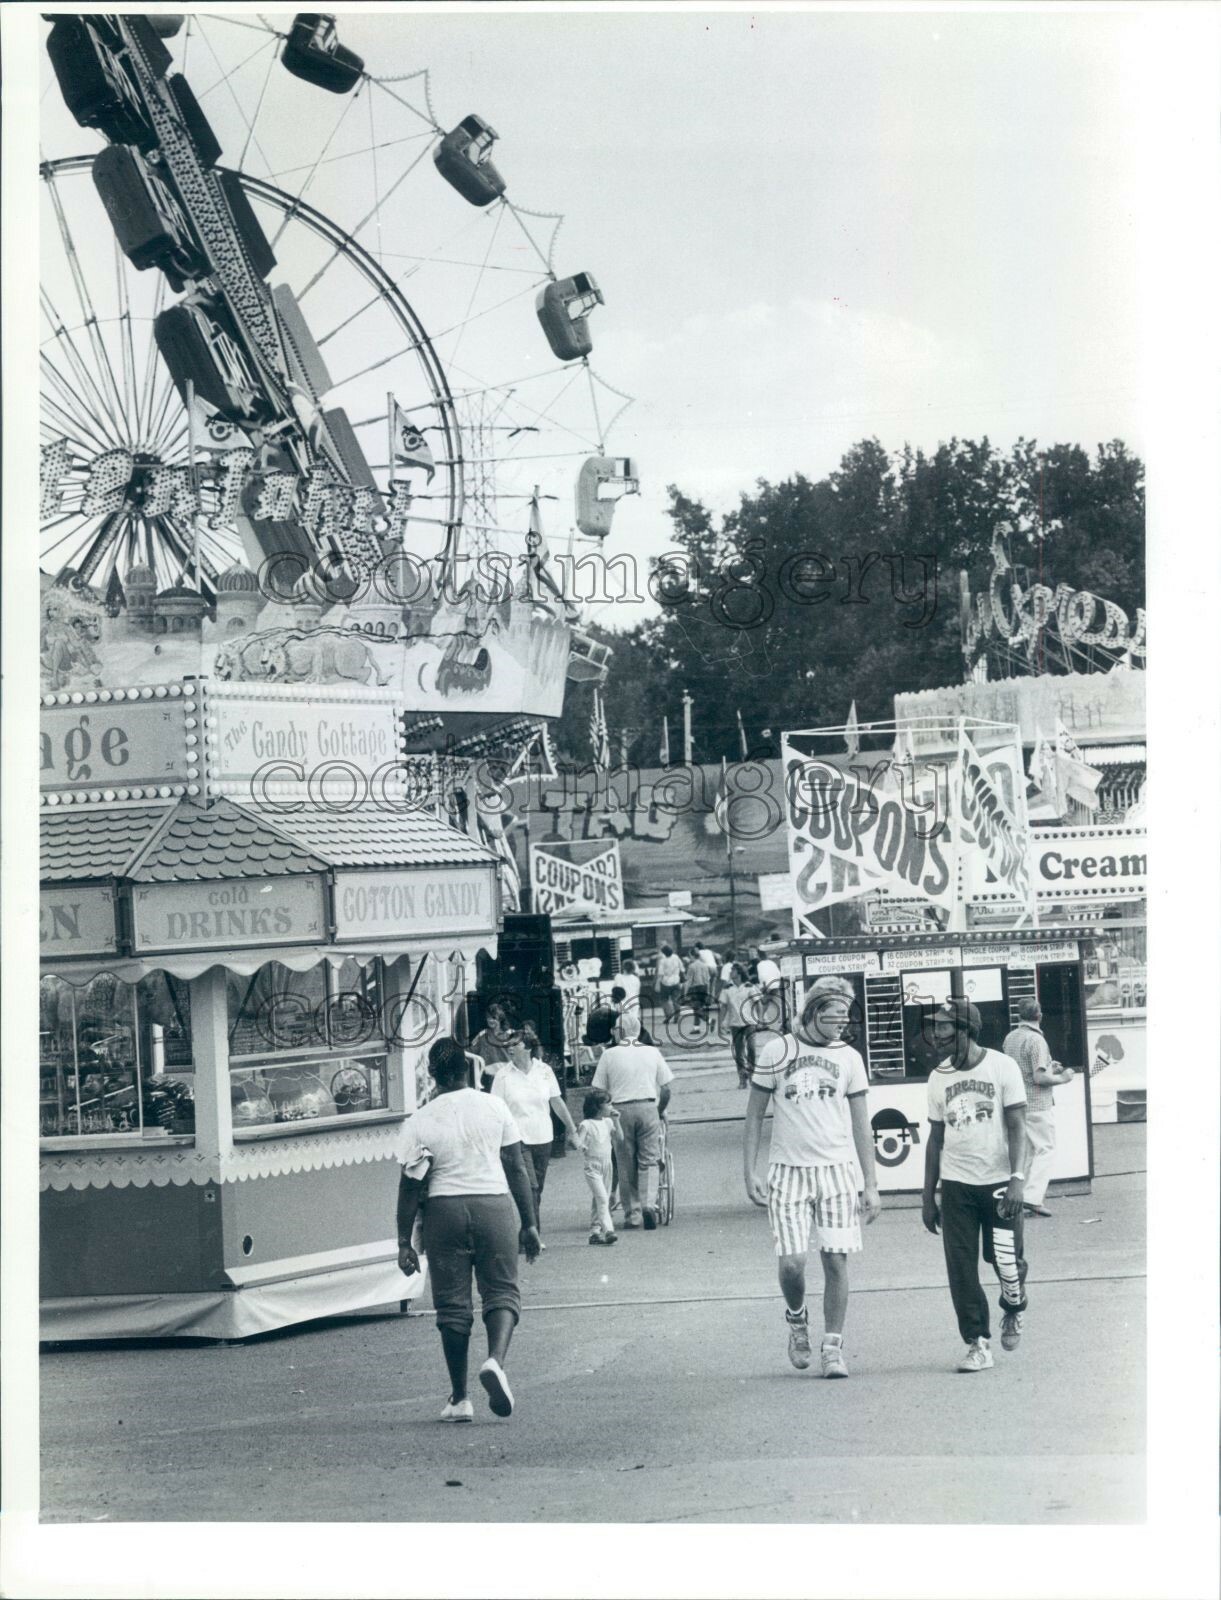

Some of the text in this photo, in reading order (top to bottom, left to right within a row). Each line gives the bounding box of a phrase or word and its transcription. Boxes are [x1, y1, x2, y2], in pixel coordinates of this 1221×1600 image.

[224, 720, 387, 765] The Candy Cottage
[788, 759, 949, 896] COUPONS
[1039, 851, 1146, 881] Cream
[535, 855, 620, 910] COUPONS
[344, 882, 481, 922] COTTON CANDY
[167, 907, 292, 940] DRINKS
[807, 955, 836, 964] SINGLE
[838, 953, 866, 962] COUPON
[818, 963, 847, 973] COUPON
[895, 951, 923, 959] COUPON
[895, 960, 923, 968] COUPON
[784, 1055, 840, 1080] ARCADE
[945, 1079, 996, 1105] ARCADE
